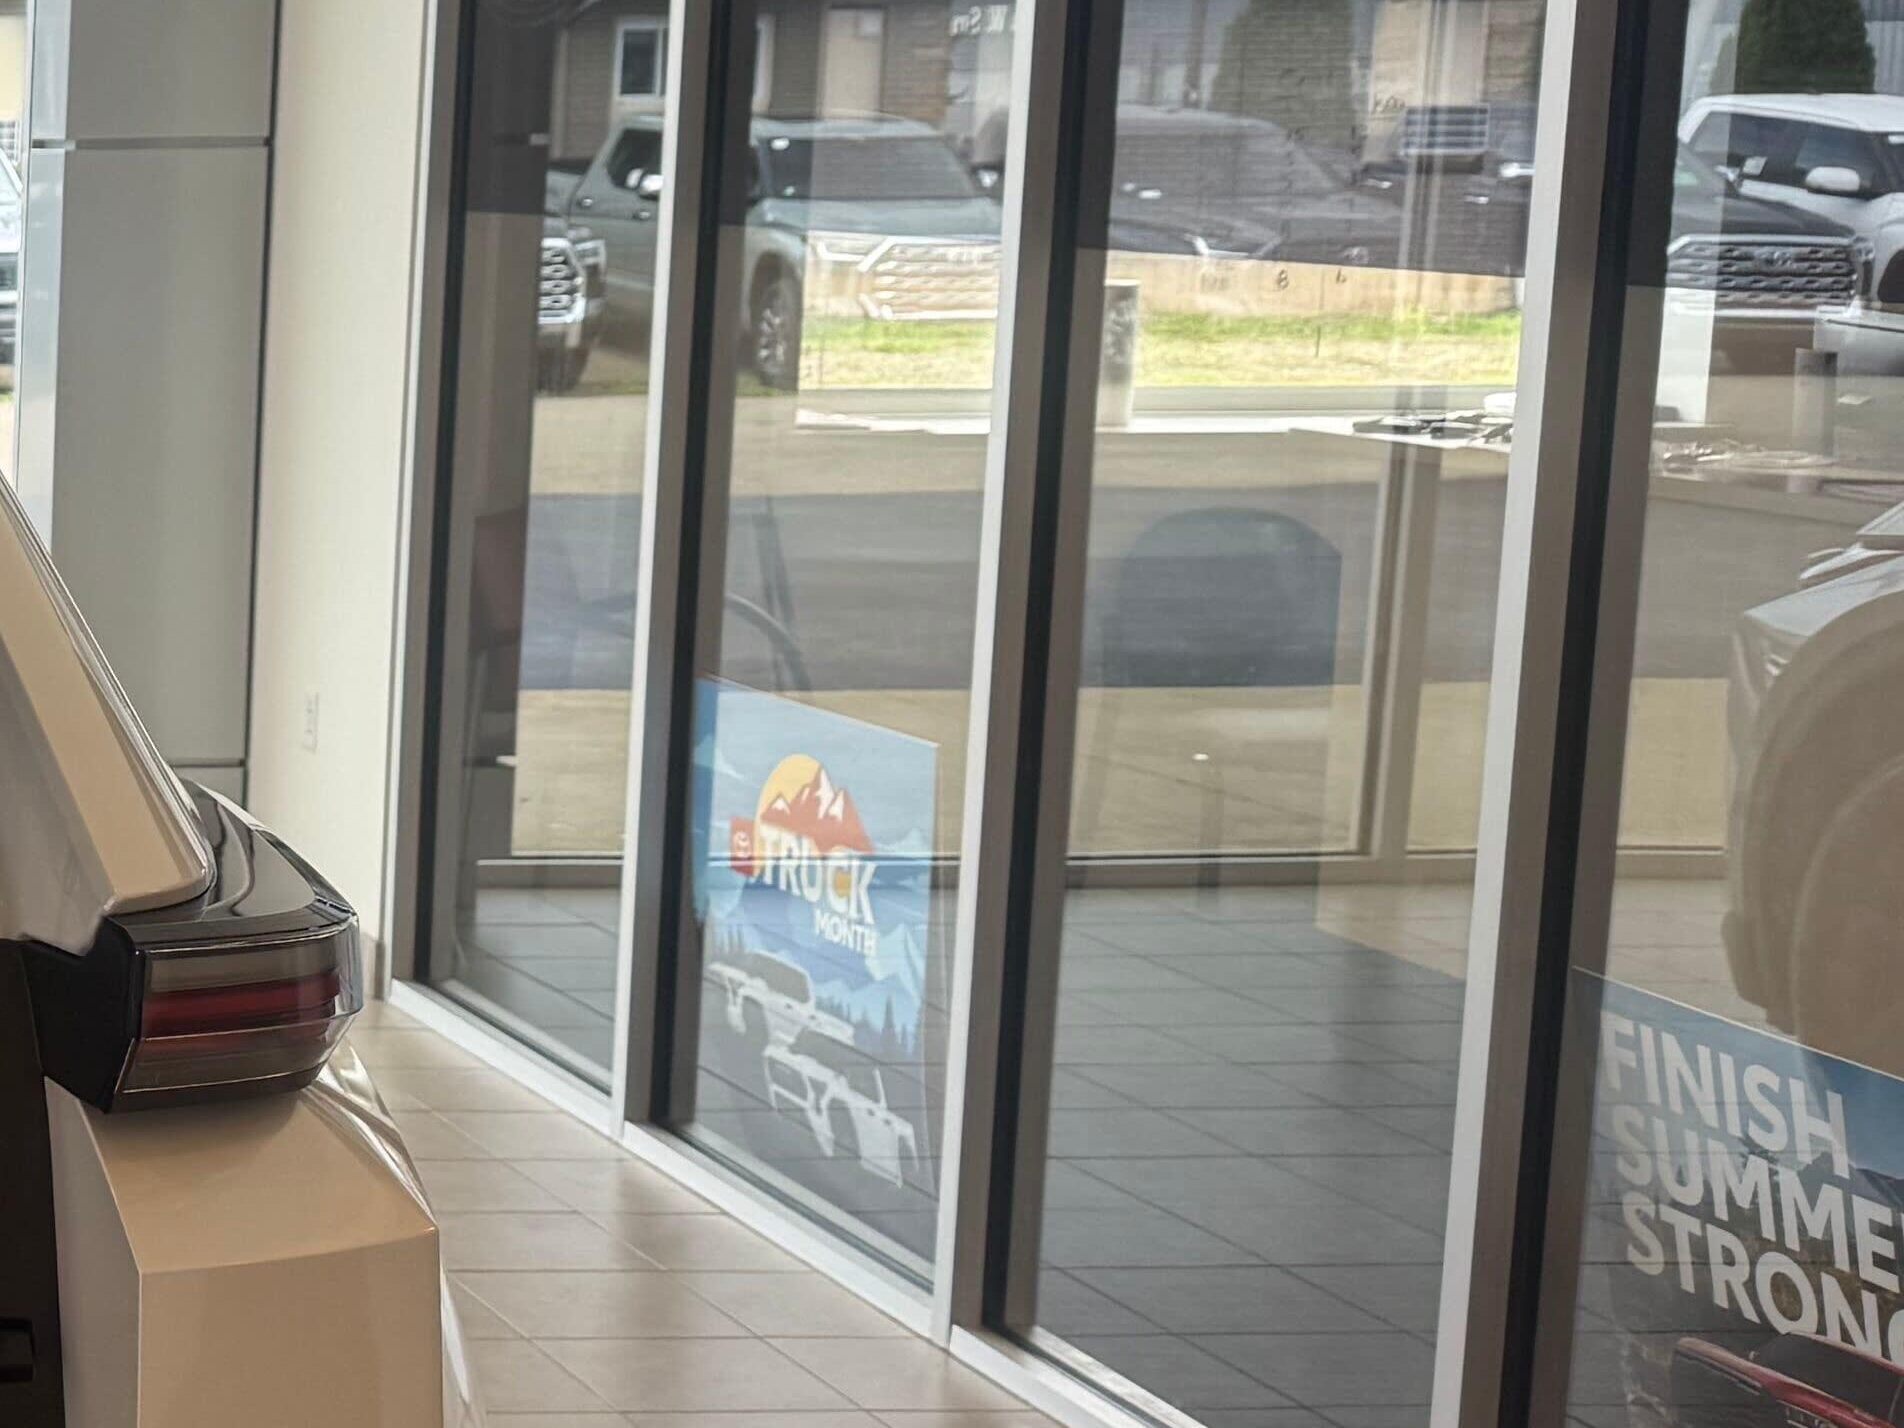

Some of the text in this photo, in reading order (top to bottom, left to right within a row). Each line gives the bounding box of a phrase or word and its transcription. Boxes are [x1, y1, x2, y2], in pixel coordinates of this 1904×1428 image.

[762, 822, 878, 925] TRUCK
[815, 907, 879, 957] MONTH
[1600, 1010, 1850, 1179] FINISH
[1611, 1104, 1904, 1294] SUMME
[1622, 1189, 1904, 1366] STRON
